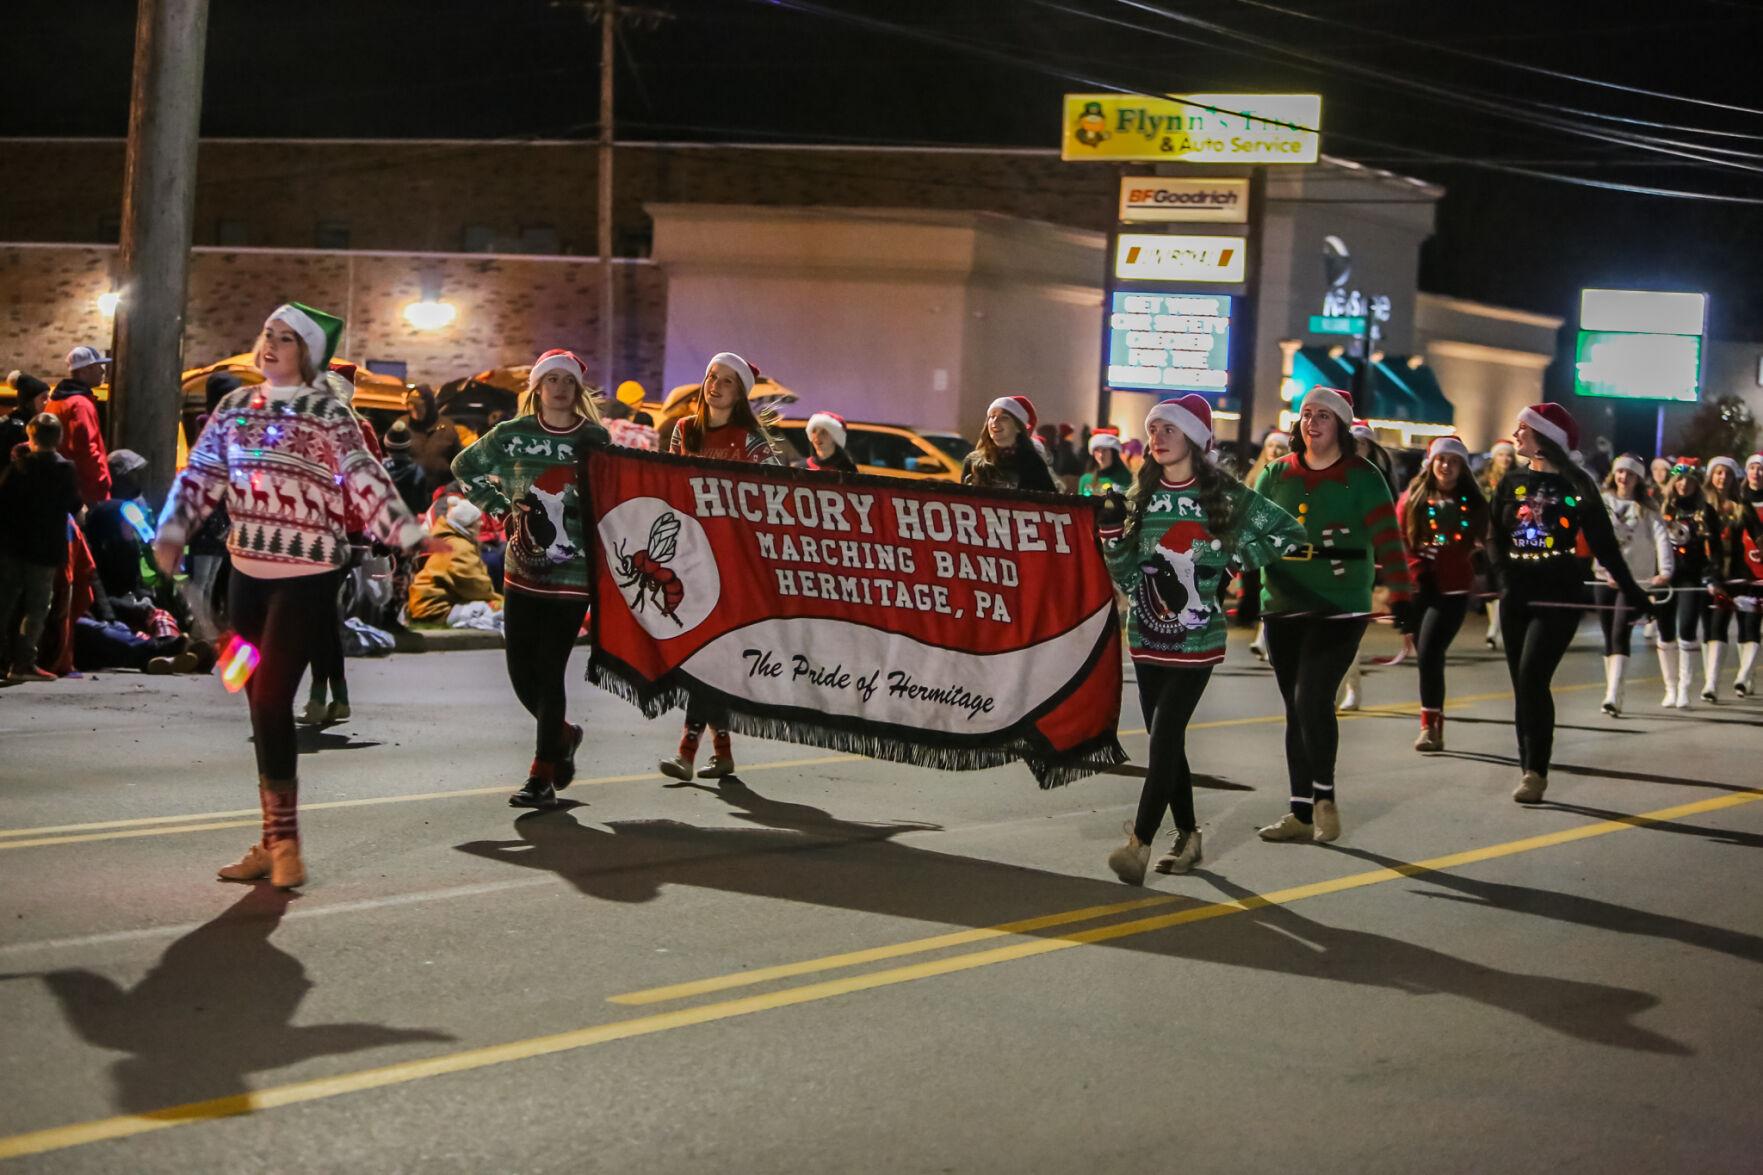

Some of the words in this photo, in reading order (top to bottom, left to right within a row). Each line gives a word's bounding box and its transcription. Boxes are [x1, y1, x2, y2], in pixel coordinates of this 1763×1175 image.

[1159, 136, 1174, 153] &
[1179, 136, 1225, 154] Auto
[1230, 136, 1303, 154] Service
[1128, 188, 1238, 205] BFGoodrich
[689, 476, 874, 535] HICKORY
[892, 496, 1073, 555] HORNET
[755, 530, 916, 574] MARCHING
[934, 550, 1020, 588] BAND
[775, 568, 966, 619] HERMITAGE,
[974, 589, 1013, 623] PA
[742, 648, 783, 679] The
[791, 654, 851, 690] Pride
[856, 670, 880, 703] of
[887, 671, 995, 721] Hermitage
